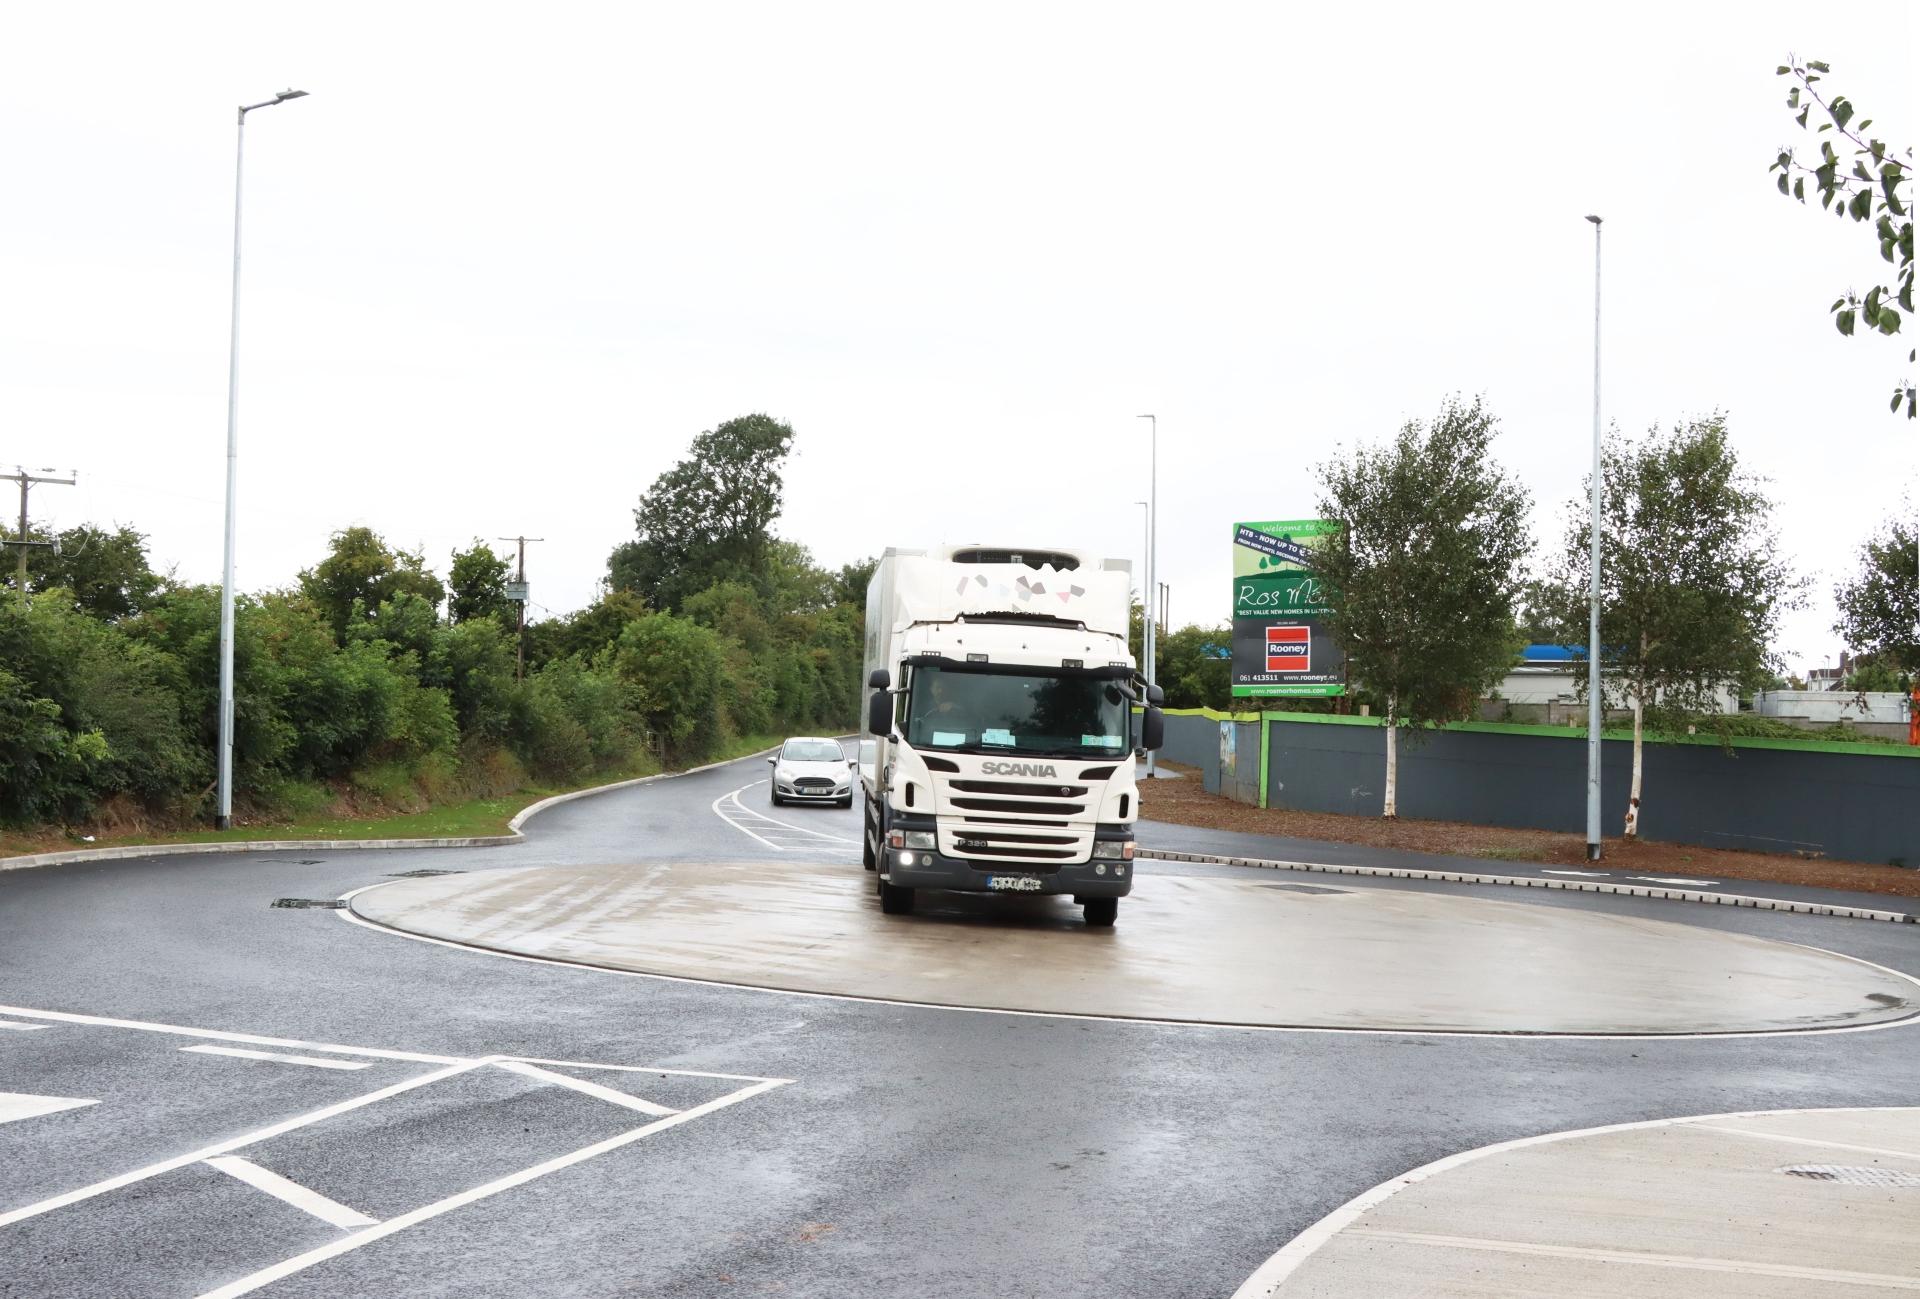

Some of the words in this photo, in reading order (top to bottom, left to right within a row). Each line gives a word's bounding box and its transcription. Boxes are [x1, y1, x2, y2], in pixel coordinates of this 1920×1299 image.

[1262, 523, 1301, 533] Welcome
[1305, 523, 1315, 531] to
[1239, 528, 1254, 538] HTB
[1259, 535, 1277, 546] NOW
[1277, 541, 1288, 549] UP
[1288, 544, 1298, 552] TO
[1238, 585, 1280, 606] Ros
[1270, 644, 1306, 654] Rooney
[981, 761, 1057, 778] SCANIA
[967, 840, 987, 848] 320
